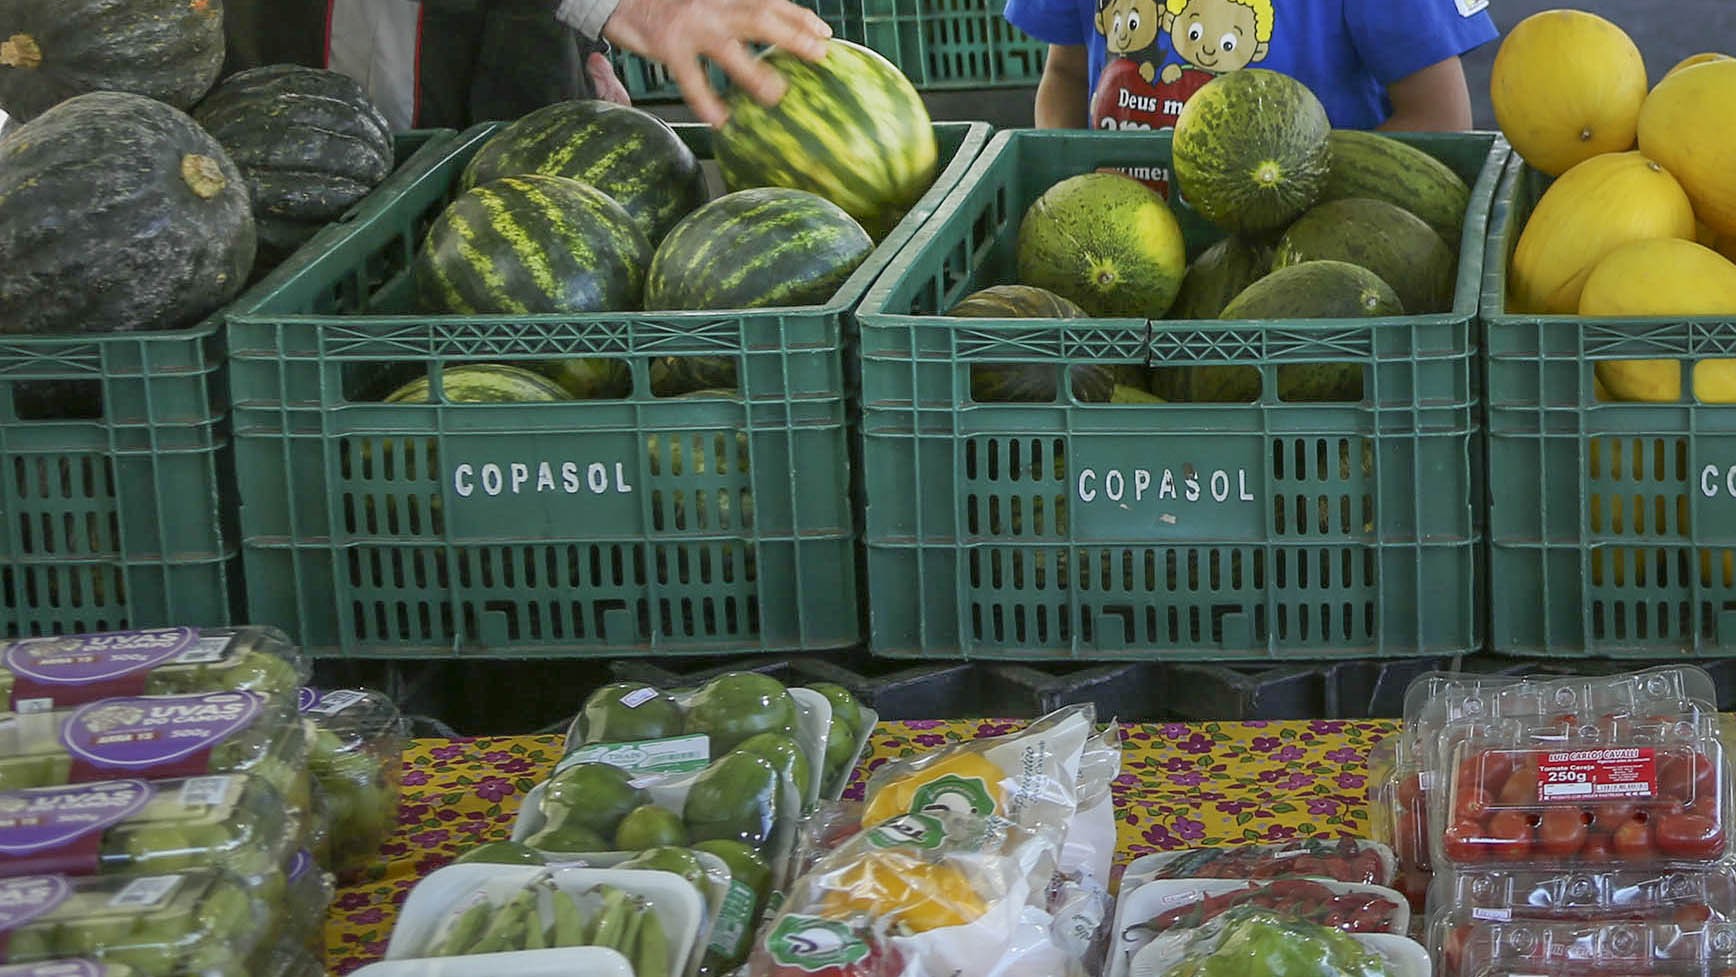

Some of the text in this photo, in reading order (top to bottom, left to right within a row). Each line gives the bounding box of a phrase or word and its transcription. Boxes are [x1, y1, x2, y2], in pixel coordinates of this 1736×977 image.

[1118, 87, 1184, 116] Deus m
[455, 461, 632, 497] COPASOL
[1079, 468, 1254, 502] COPASOL
[90, 632, 181, 646] UVAS
[151, 703, 246, 718] UVAS
[1548, 748, 1640, 762] LUIZ CARLOS CAVALLI
[1548, 771, 1587, 783] 250g
